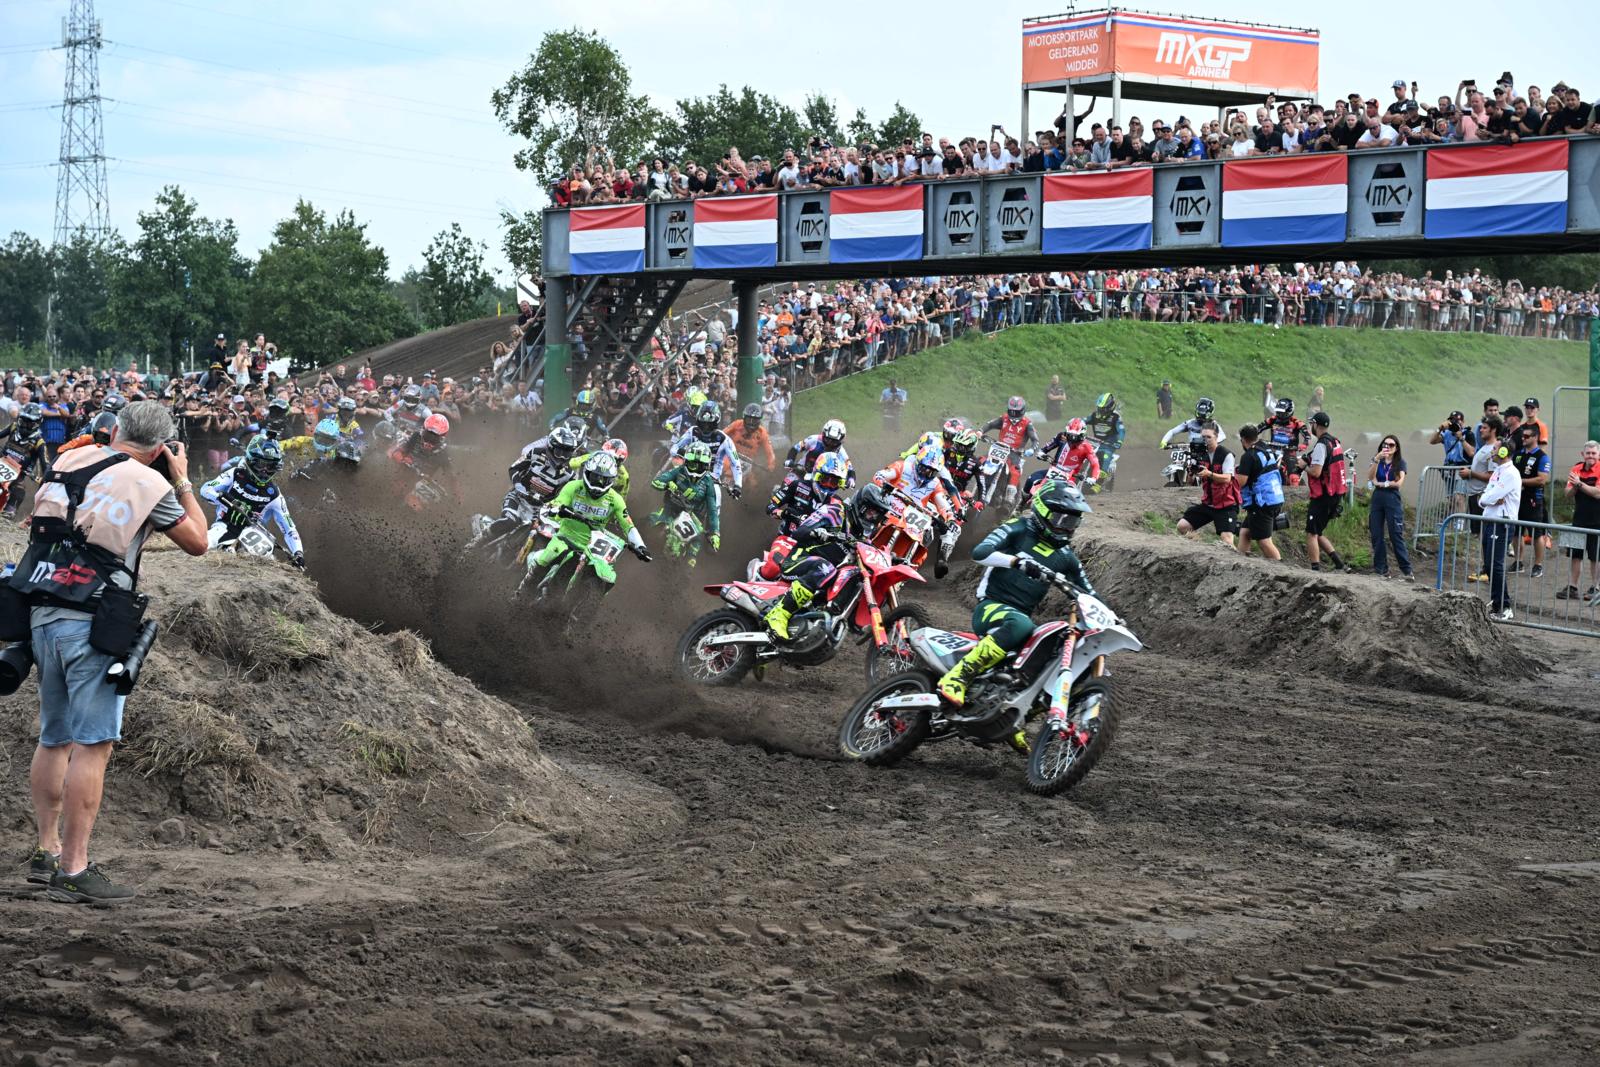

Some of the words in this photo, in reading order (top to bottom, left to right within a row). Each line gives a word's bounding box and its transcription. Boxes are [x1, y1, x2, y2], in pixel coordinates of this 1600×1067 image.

[1029, 28, 1098, 48] MOTORSPORTPARK
[1049, 43, 1099, 60] GELDERLAND
[1155, 32, 1252, 70] MXGP
[1066, 58, 1098, 72] MIDDEN
[1188, 66, 1230, 79] ARNHEM
[1372, 184, 1406, 208] MX
[1176, 196, 1205, 217] MX
[949, 210, 975, 229] MX
[1002, 207, 1029, 226] MX
[667, 227, 689, 244] MX
[801, 219, 823, 237] MX
[675, 521, 696, 538] 3
[906, 512, 928, 530] 84
[241, 531, 273, 556] 93
[590, 538, 619, 563] 91
[928, 632, 971, 650] 259
